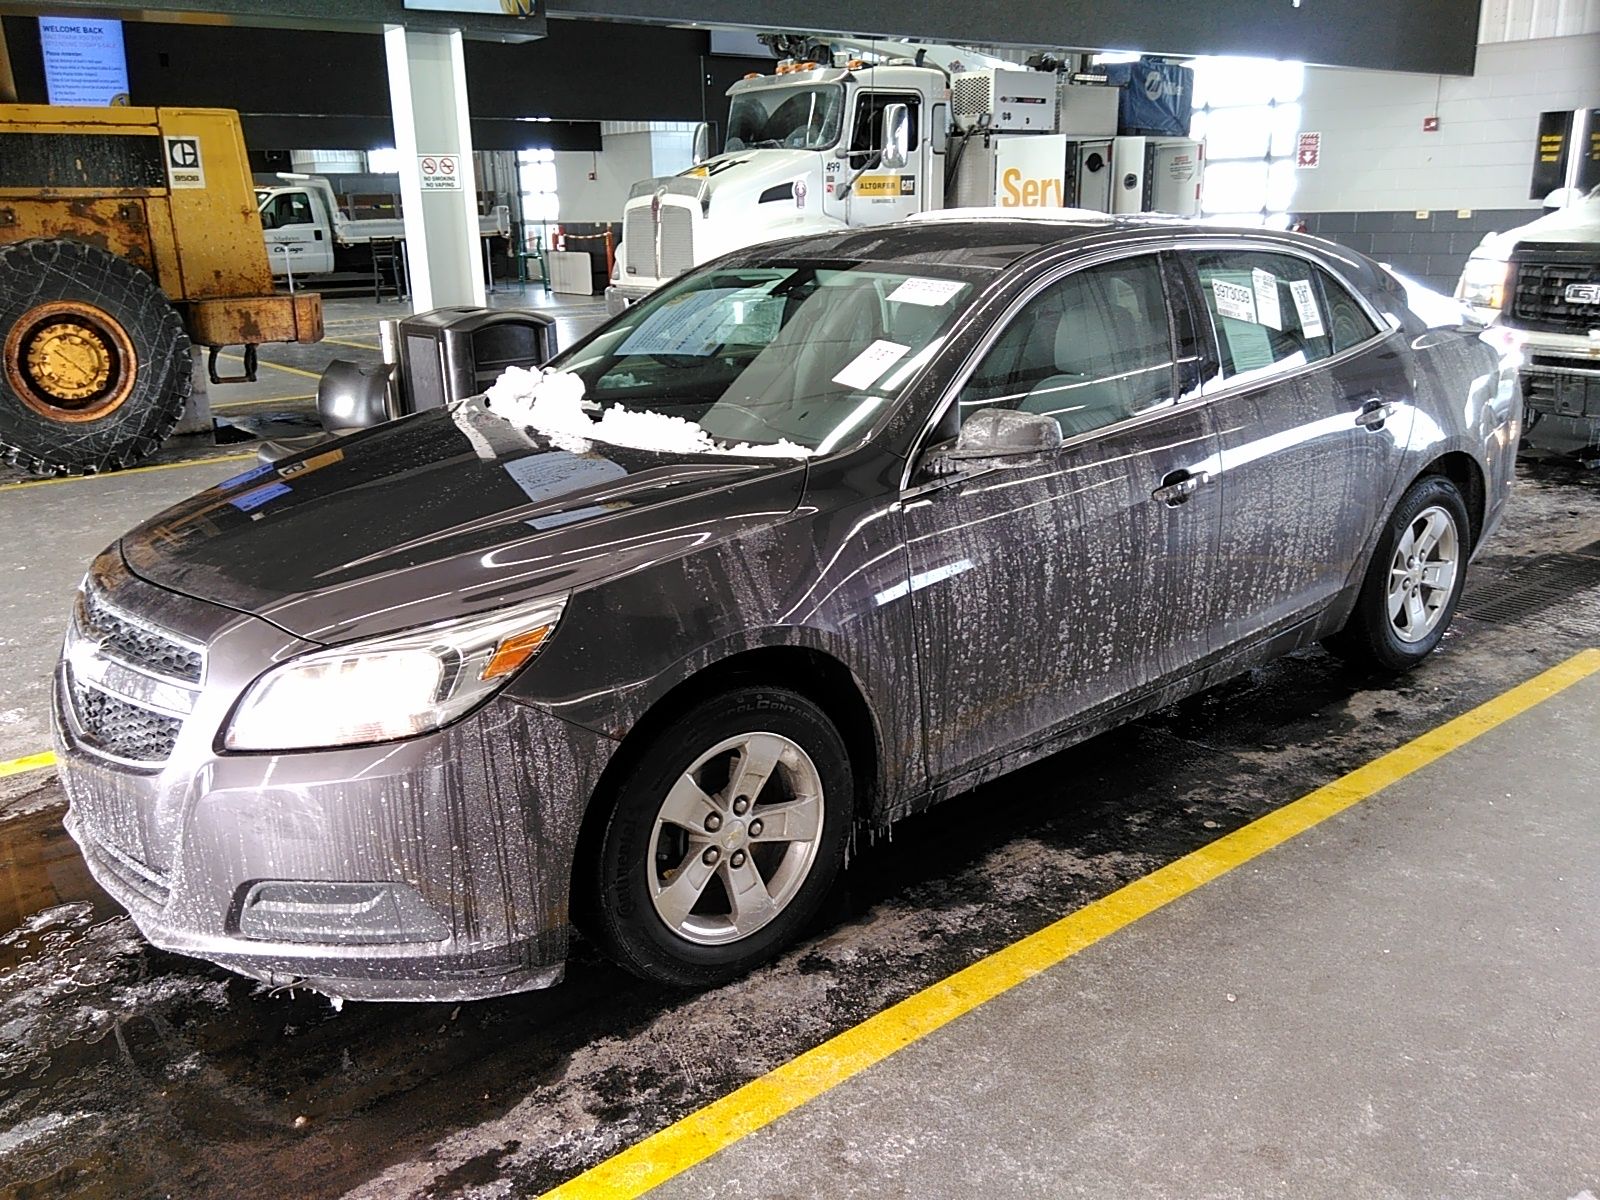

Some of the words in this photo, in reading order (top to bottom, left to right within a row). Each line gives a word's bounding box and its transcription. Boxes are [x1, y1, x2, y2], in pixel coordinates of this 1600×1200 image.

[43, 25, 81, 33] WELCOME
[83, 26, 104, 34] BACK
[826, 162, 840, 172] 499
[901, 180, 915, 191] CAT
